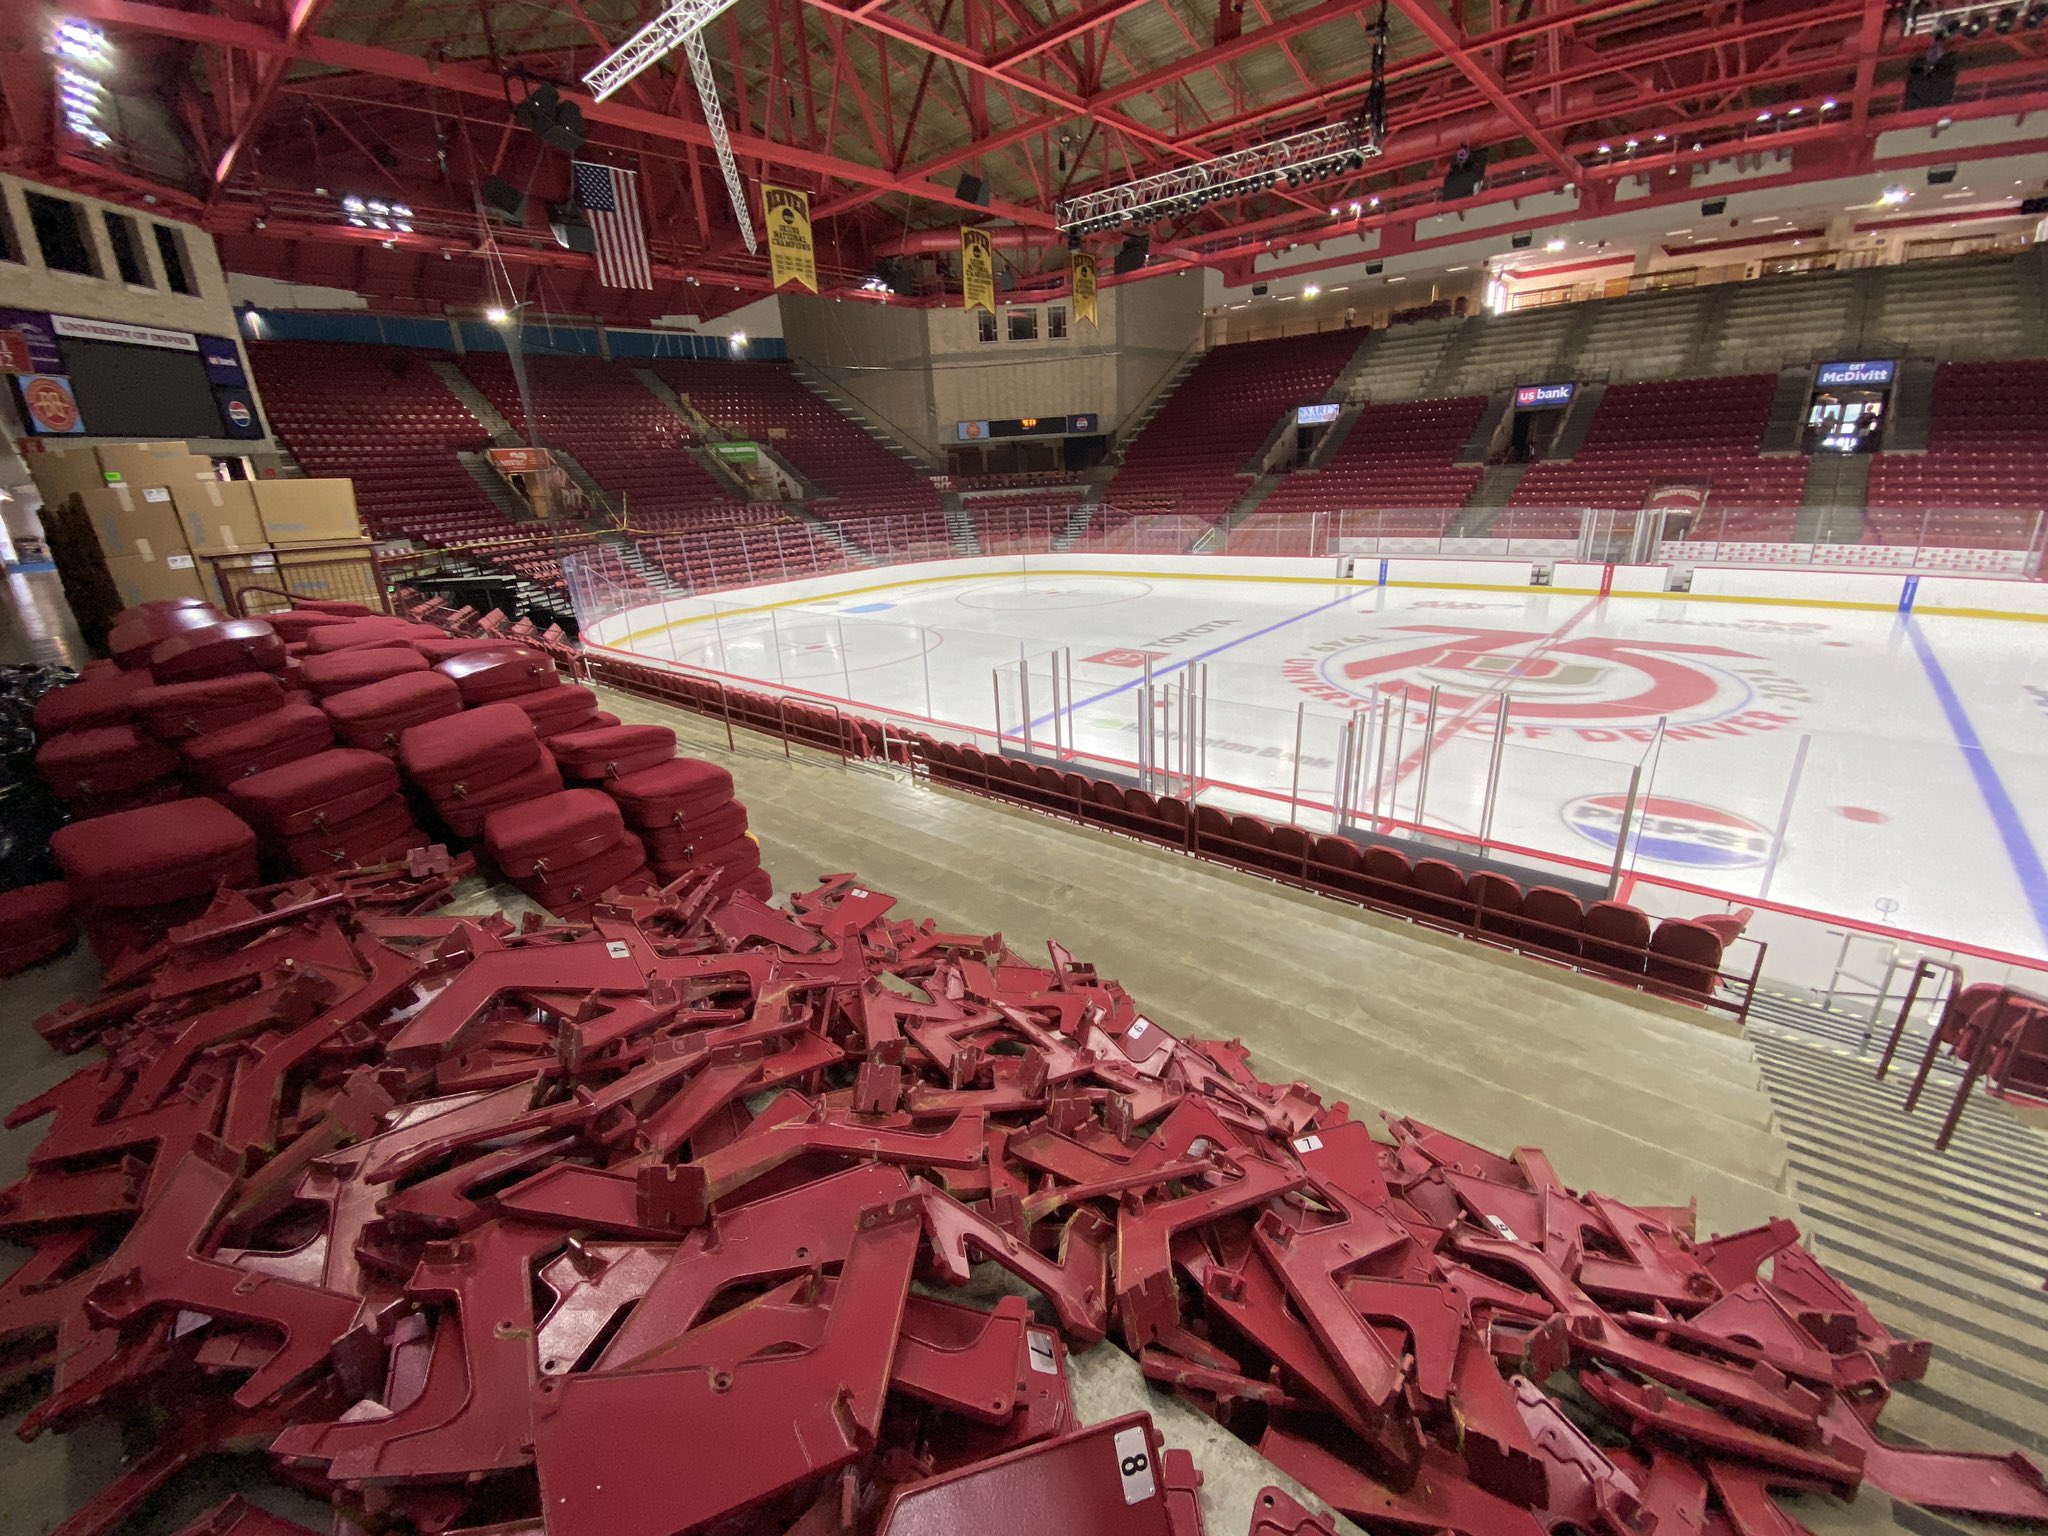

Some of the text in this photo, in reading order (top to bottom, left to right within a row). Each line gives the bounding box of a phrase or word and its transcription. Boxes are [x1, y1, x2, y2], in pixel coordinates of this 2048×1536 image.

[59, 321, 131, 338] UNIVERSITY
[1822, 369, 1888, 383] McDivitt
[1848, 363, 1867, 371] GET
[1520, 387, 1570, 401] us bank
[1141, 619, 1242, 648] TOYOTA
[1464, 722, 1553, 740] OF
[1573, 710, 1801, 743] DENVER
[1574, 806, 1767, 851] PEPSI
[1121, 1453, 1148, 1476] 8
